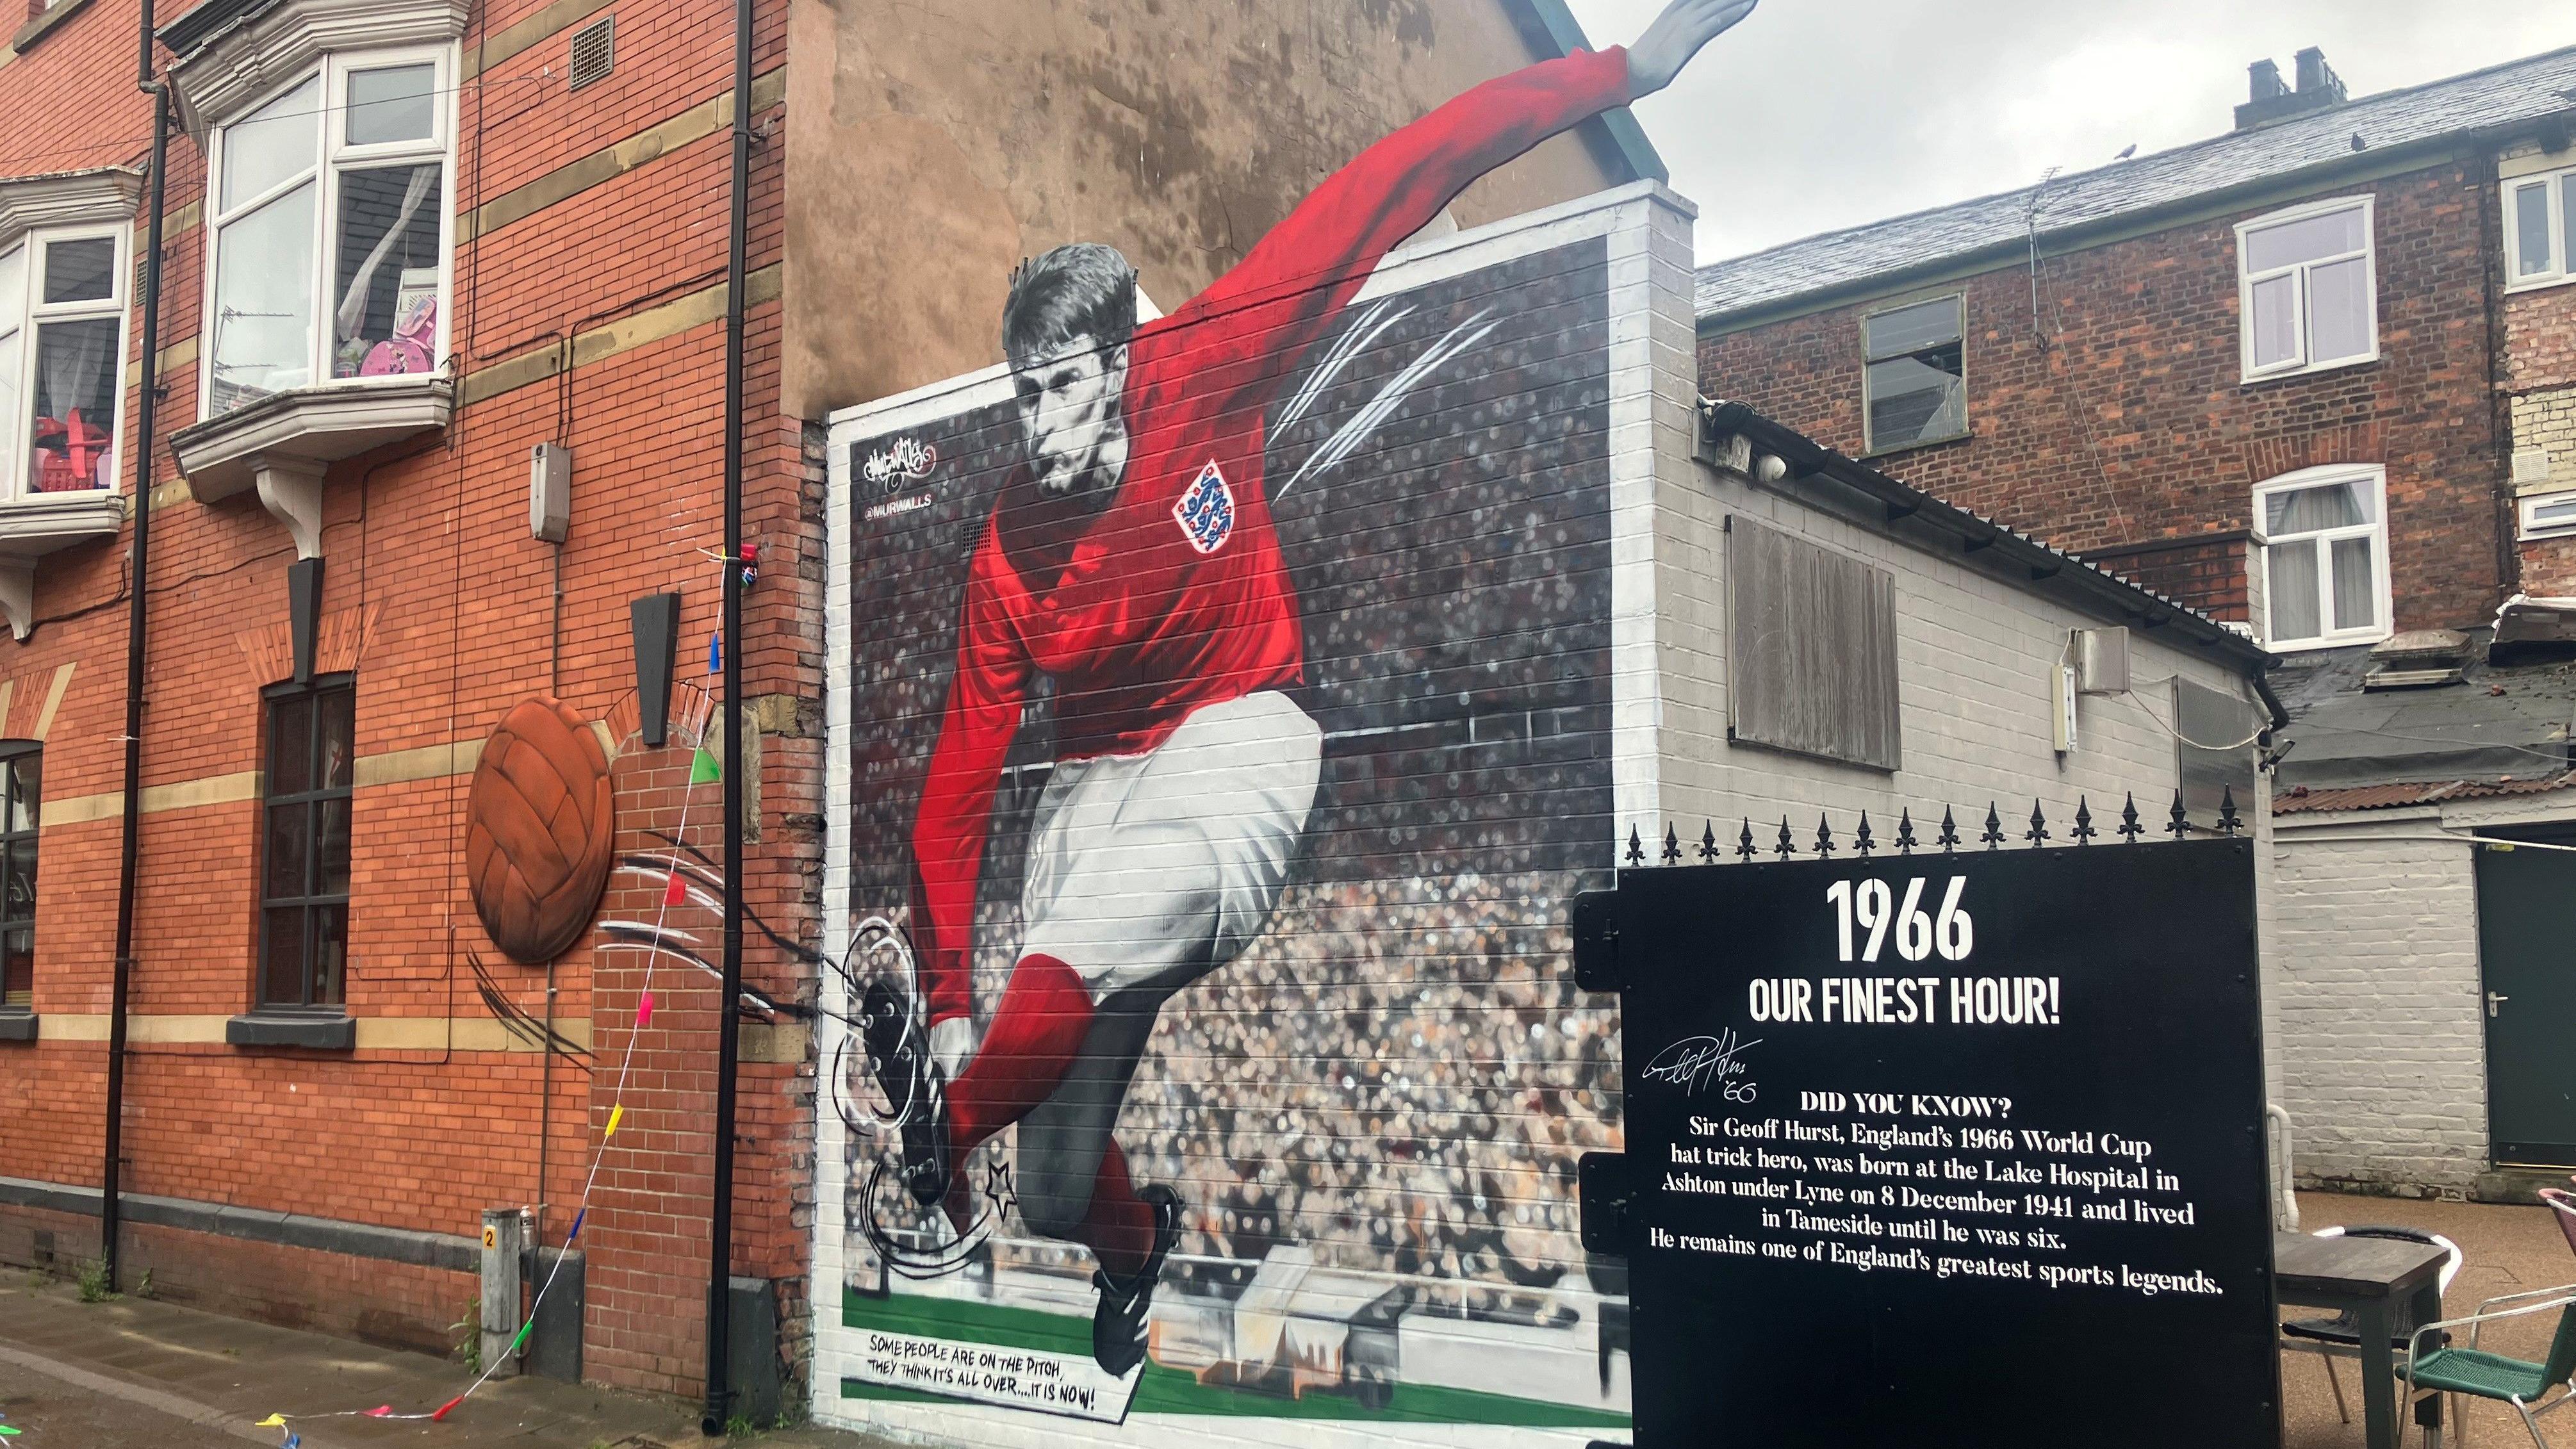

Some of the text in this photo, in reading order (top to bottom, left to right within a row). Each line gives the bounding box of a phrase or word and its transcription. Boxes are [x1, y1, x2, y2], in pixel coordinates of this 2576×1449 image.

[865, 493, 931, 521] @MURWALLS
[1826, 875, 1973, 963] 1966
[1749, 976, 2060, 1024] OUR FINEST HOUR!
[1800, 1091, 2012, 1118] DID YOU KNOW?
[1689, 1115, 2152, 1163] Sir Geoff Hurst, England's 1966 World Cup
[1670, 1142, 2179, 1194] hat trick hero, was born at the Lake Hospital in
[1661, 1172, 2195, 1225] Ashton under Lyne on 8 December 1941 and lived
[486, 1231, 493, 1247] 2
[1762, 1207, 2067, 1250] in Tameside until he was six.
[1650, 1227, 2223, 1296] He remains one of England's greatest sports legends.
[870, 1334, 901, 1355] SOME
[905, 1341, 949, 1361] PEOPLE
[951, 1347, 974, 1365] ARE
[980, 1352, 996, 1368] ON
[998, 1355, 1023, 1373] THE
[867, 1359, 897, 1376] THEY
[901, 1363, 931, 1380] THINK
[934, 1367, 953, 1383] IT'S
[957, 1371, 978, 1386] ALL
[1044, 1383, 1055, 1400] IS
[1060, 1386, 1095, 1411] NOW!
